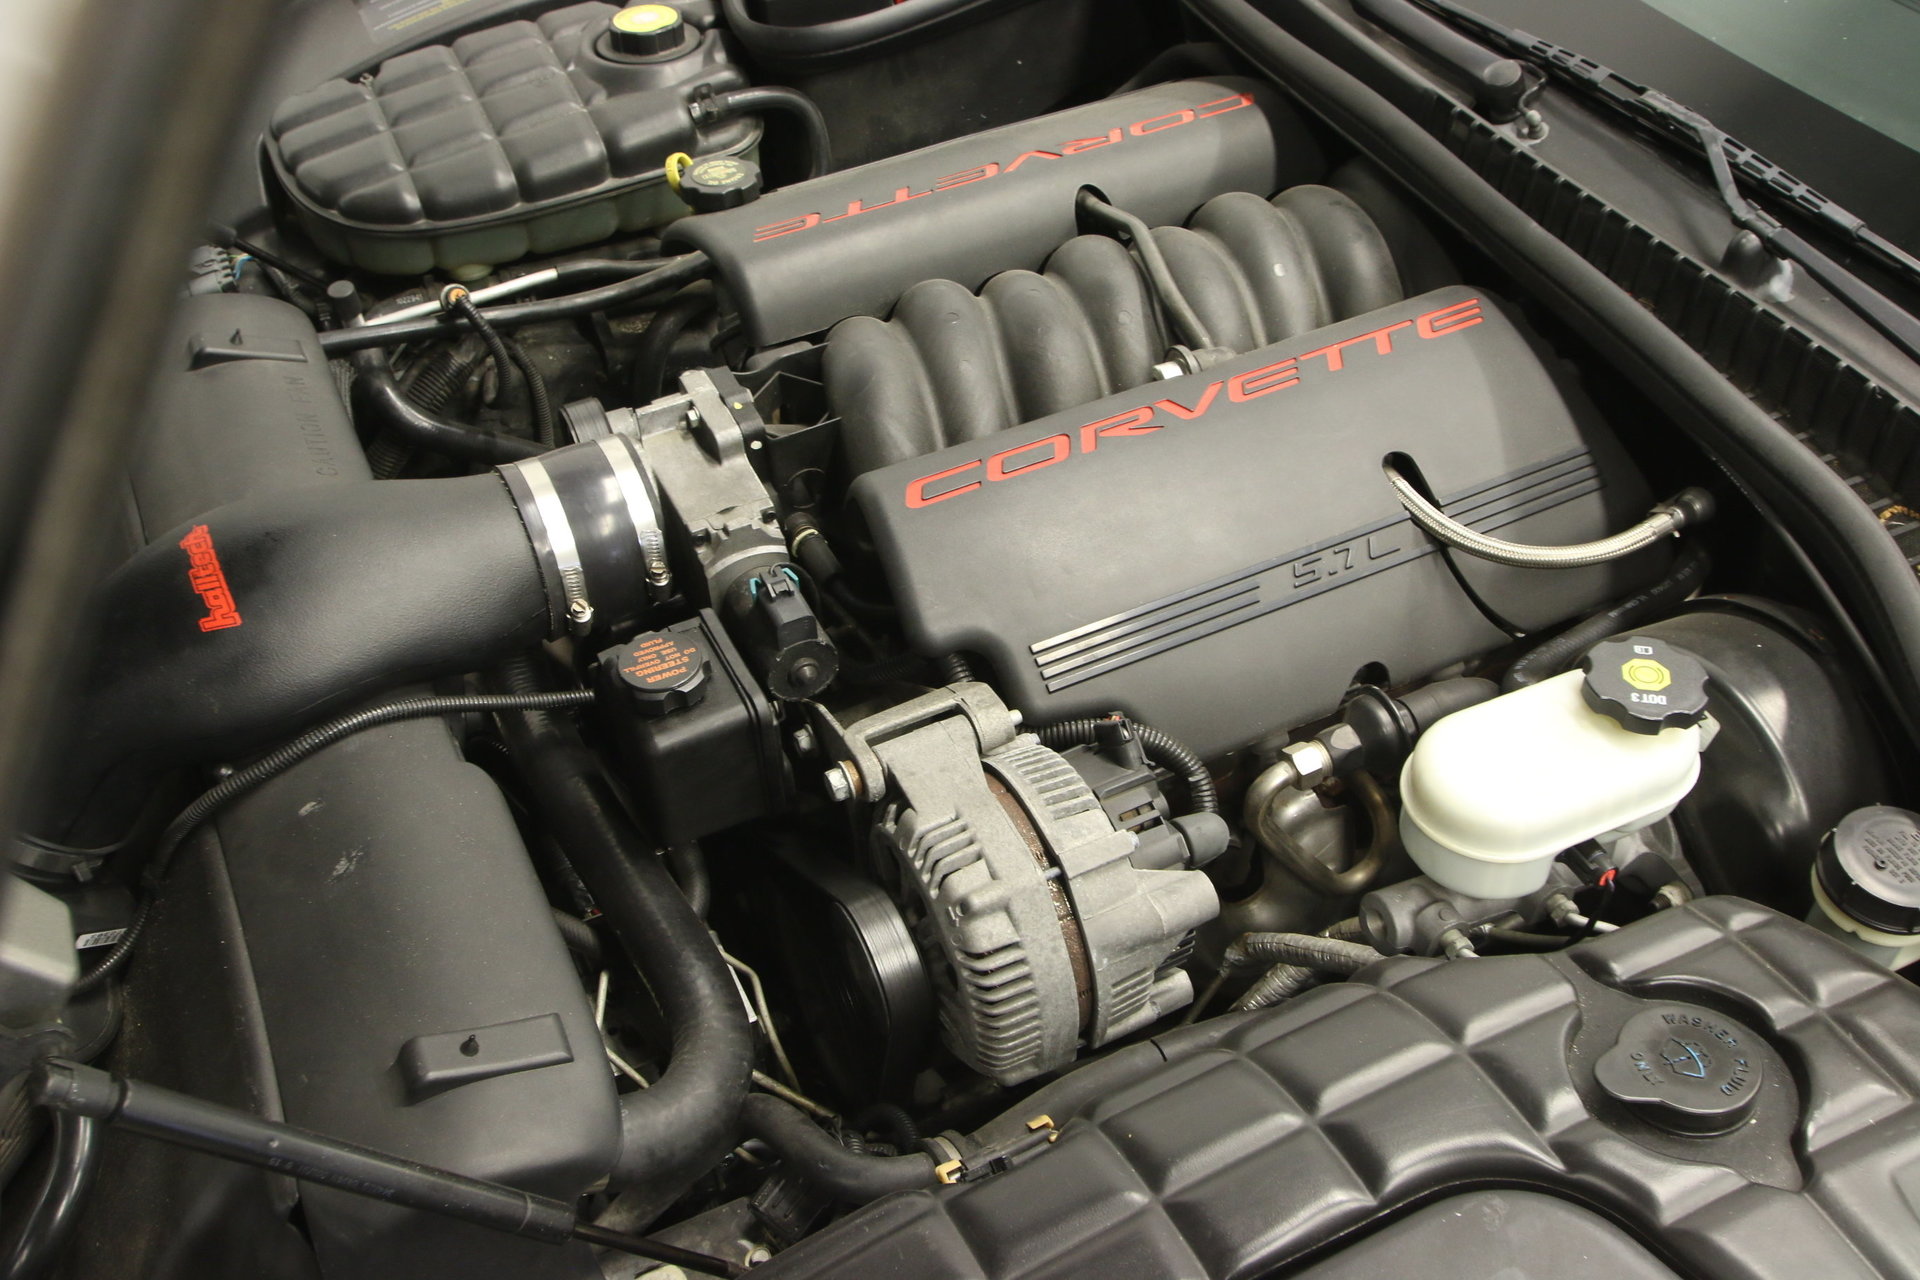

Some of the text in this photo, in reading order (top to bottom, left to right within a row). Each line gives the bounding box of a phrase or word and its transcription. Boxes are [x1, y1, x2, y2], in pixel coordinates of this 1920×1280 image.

[753, 93, 1254, 242] CORVETTE
[905, 298, 1484, 509] CORVETTE
[1293, 536, 1401, 588] 5.7L
[638, 653, 657, 662] ONLY
[665, 652, 681, 661] NOT
[683, 647, 696, 655] DO
[635, 656, 689, 677] STEERING
[645, 666, 688, 683] POWER
[1630, 692, 1667, 706] DOT 3
[1630, 1013, 1750, 1096] WASHER FLUID ONLY
